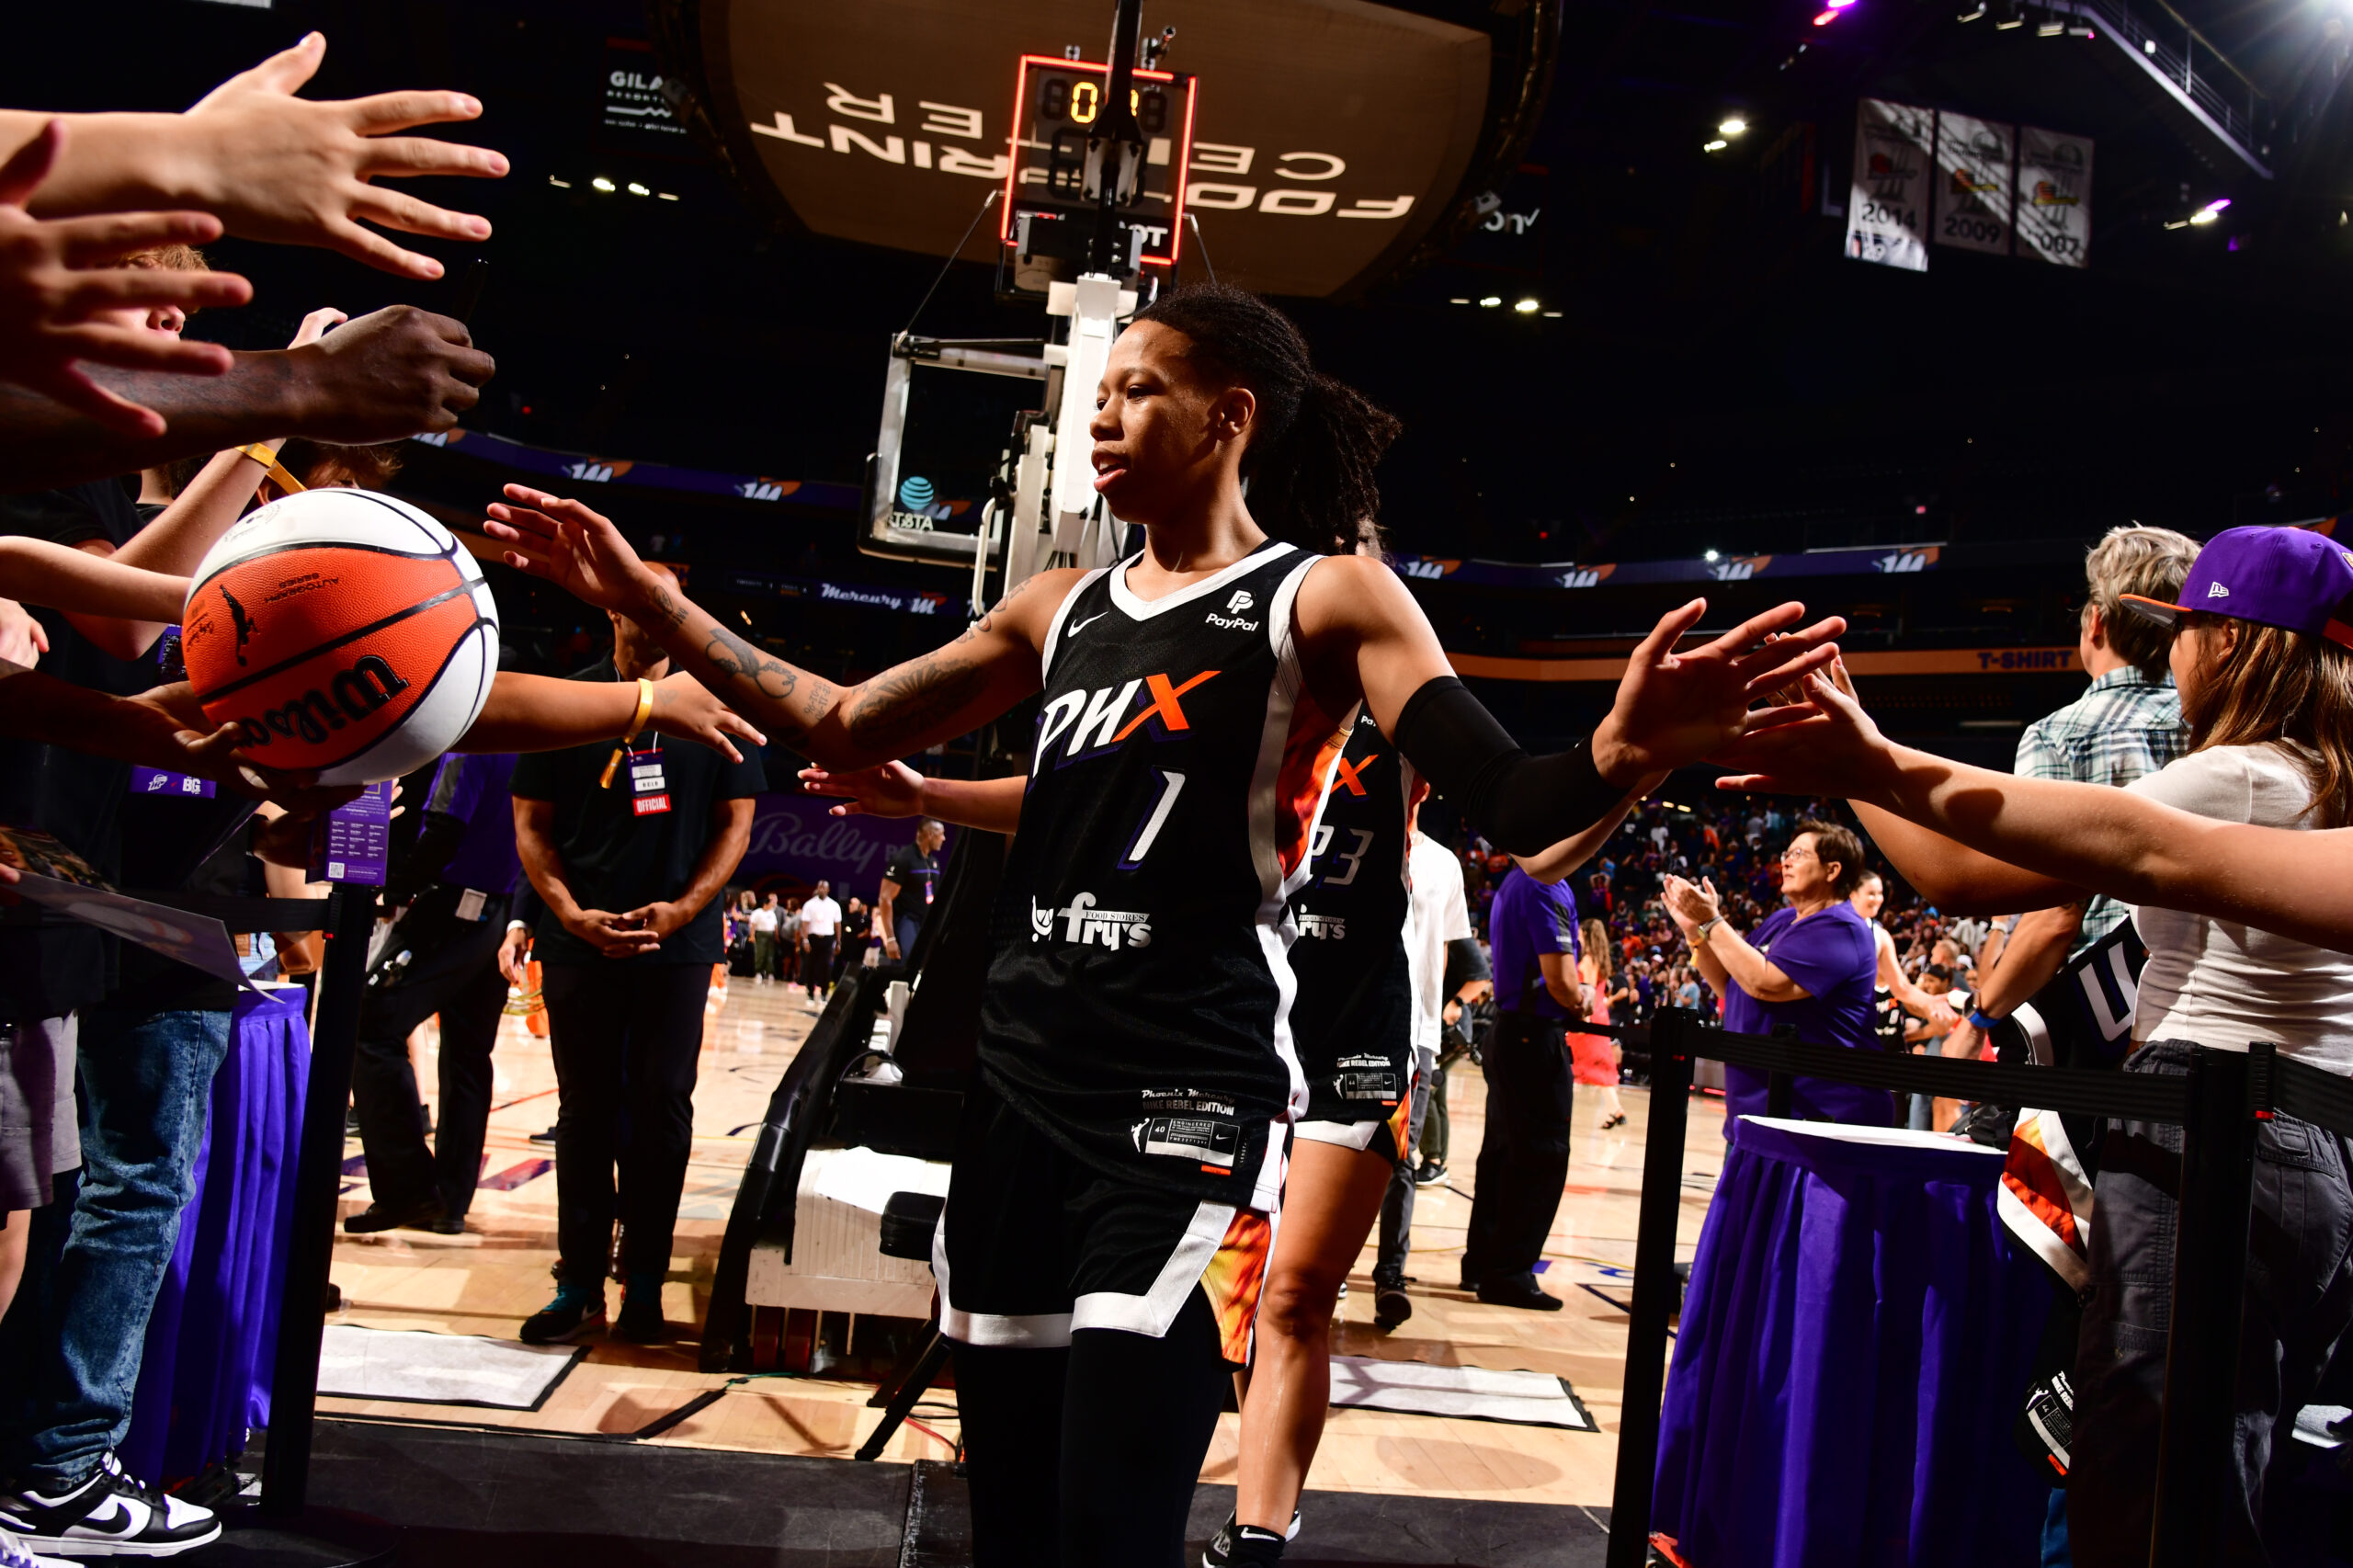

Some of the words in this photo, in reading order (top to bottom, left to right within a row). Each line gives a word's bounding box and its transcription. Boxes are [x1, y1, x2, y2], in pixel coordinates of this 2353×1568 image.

[609, 71, 664, 90] GILA
[824, 83, 1346, 181] CETER
[750, 111, 1415, 219] FOOPRINT
[1862, 203, 1916, 230] 2014
[1945, 217, 2002, 244] 2009
[821, 583, 903, 609] Mercury
[1205, 612, 1259, 631] PayPal
[1977, 650, 2073, 670] T-SHIRT
[1029, 671, 1222, 781] PHX
[635, 797, 668, 813] OFFICIAL
[1121, 768, 1187, 866] 1
[746, 812, 880, 874] Bally
[1057, 892, 1152, 951] fry's
[1086, 911, 1108, 920] FOOD
[1110, 912, 1146, 922] STORES
[1142, 1088, 1183, 1098] Phoenix
[1188, 1088, 1235, 1104] Mercury
[1142, 1099, 1165, 1110] NIKE
[1165, 1099, 1195, 1110] REBEL
[1196, 1101, 1235, 1116] EDITION
[1154, 1125, 1165, 1133] 40
